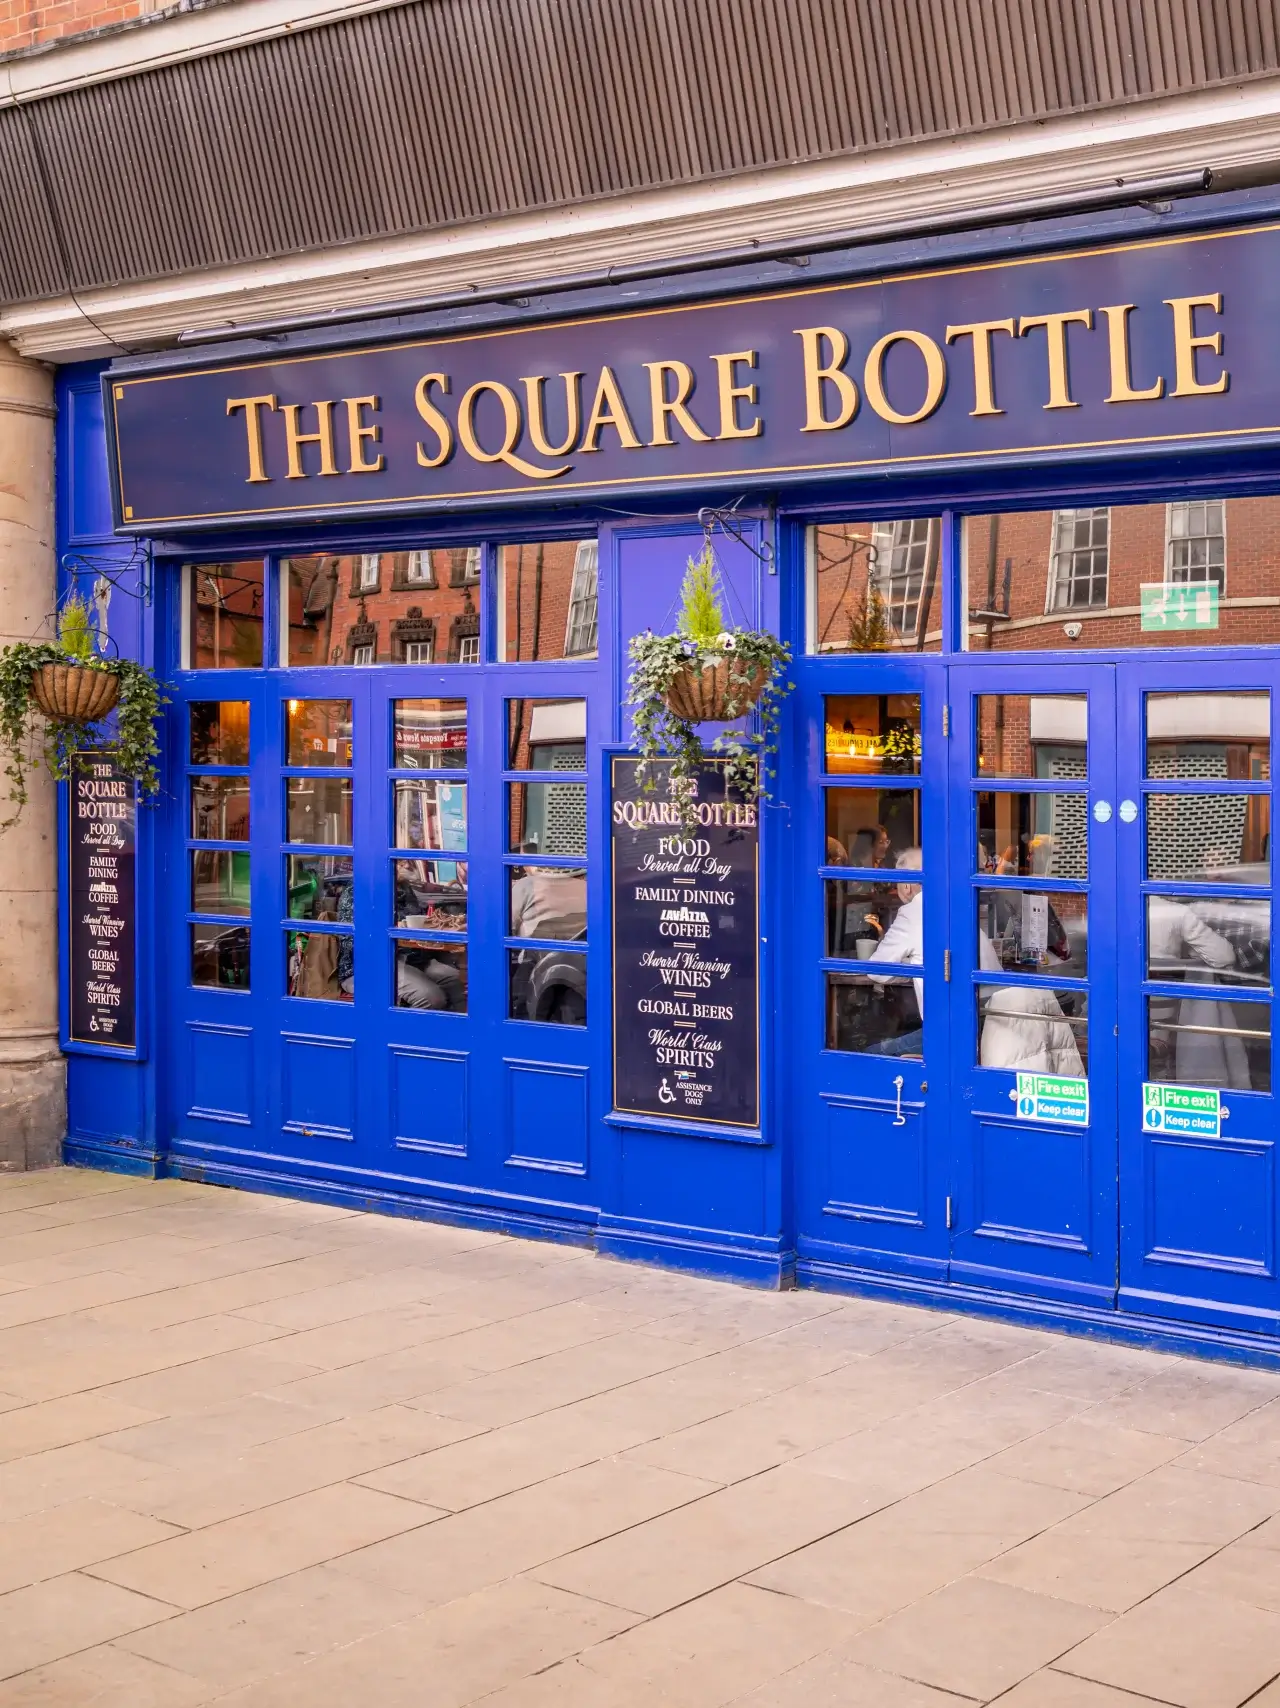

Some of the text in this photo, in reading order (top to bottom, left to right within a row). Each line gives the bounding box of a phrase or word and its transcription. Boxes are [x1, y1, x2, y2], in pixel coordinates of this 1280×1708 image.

[226, 292, 1230, 483] THE SQUARE BOTTLE
[93, 764, 112, 777] THE
[78, 781, 127, 801] SQUARE
[78, 801, 127, 819] BOTTLE
[613, 800, 681, 829] SQUARE
[90, 822, 116, 835] FOOD
[81, 834, 125, 848] Served all Day
[659, 838, 710, 857] FOOD
[89, 857, 117, 867] FAMILY
[638, 854, 732, 881] Served all Day
[88, 867, 118, 879] DINING
[90, 882, 117, 892] LAVAZZA
[88, 892, 118, 904] COFFEE
[635, 887, 735, 905] FAMILY DINING
[82, 914, 125, 931] Award Winning
[660, 907, 709, 923] LAVAZZA
[89, 925, 118, 938] WINES
[659, 923, 710, 938] COFFEE
[88, 949, 119, 961] GLOBAL
[92, 960, 115, 972] BEERS
[639, 950, 731, 980] Award Winning
[660, 968, 711, 988] WINES
[86, 981, 121, 994] World Class
[87, 992, 120, 1006] SPIRITS
[638, 999, 733, 1020] GLOBAL BEERS
[648, 1028, 689, 1049] World
[656, 1048, 714, 1068] SPIRITS
[676, 1081, 712, 1092] ASSISTANCE
[684, 1089, 703, 1098] DOGS
[1037, 1079, 1085, 1097] Fire exit
[685, 1097, 703, 1106] ONLY
[1165, 1091, 1216, 1108] Fire exit
[1038, 1102, 1085, 1117] Keep clear
[1165, 1114, 1216, 1130] Keep clear
